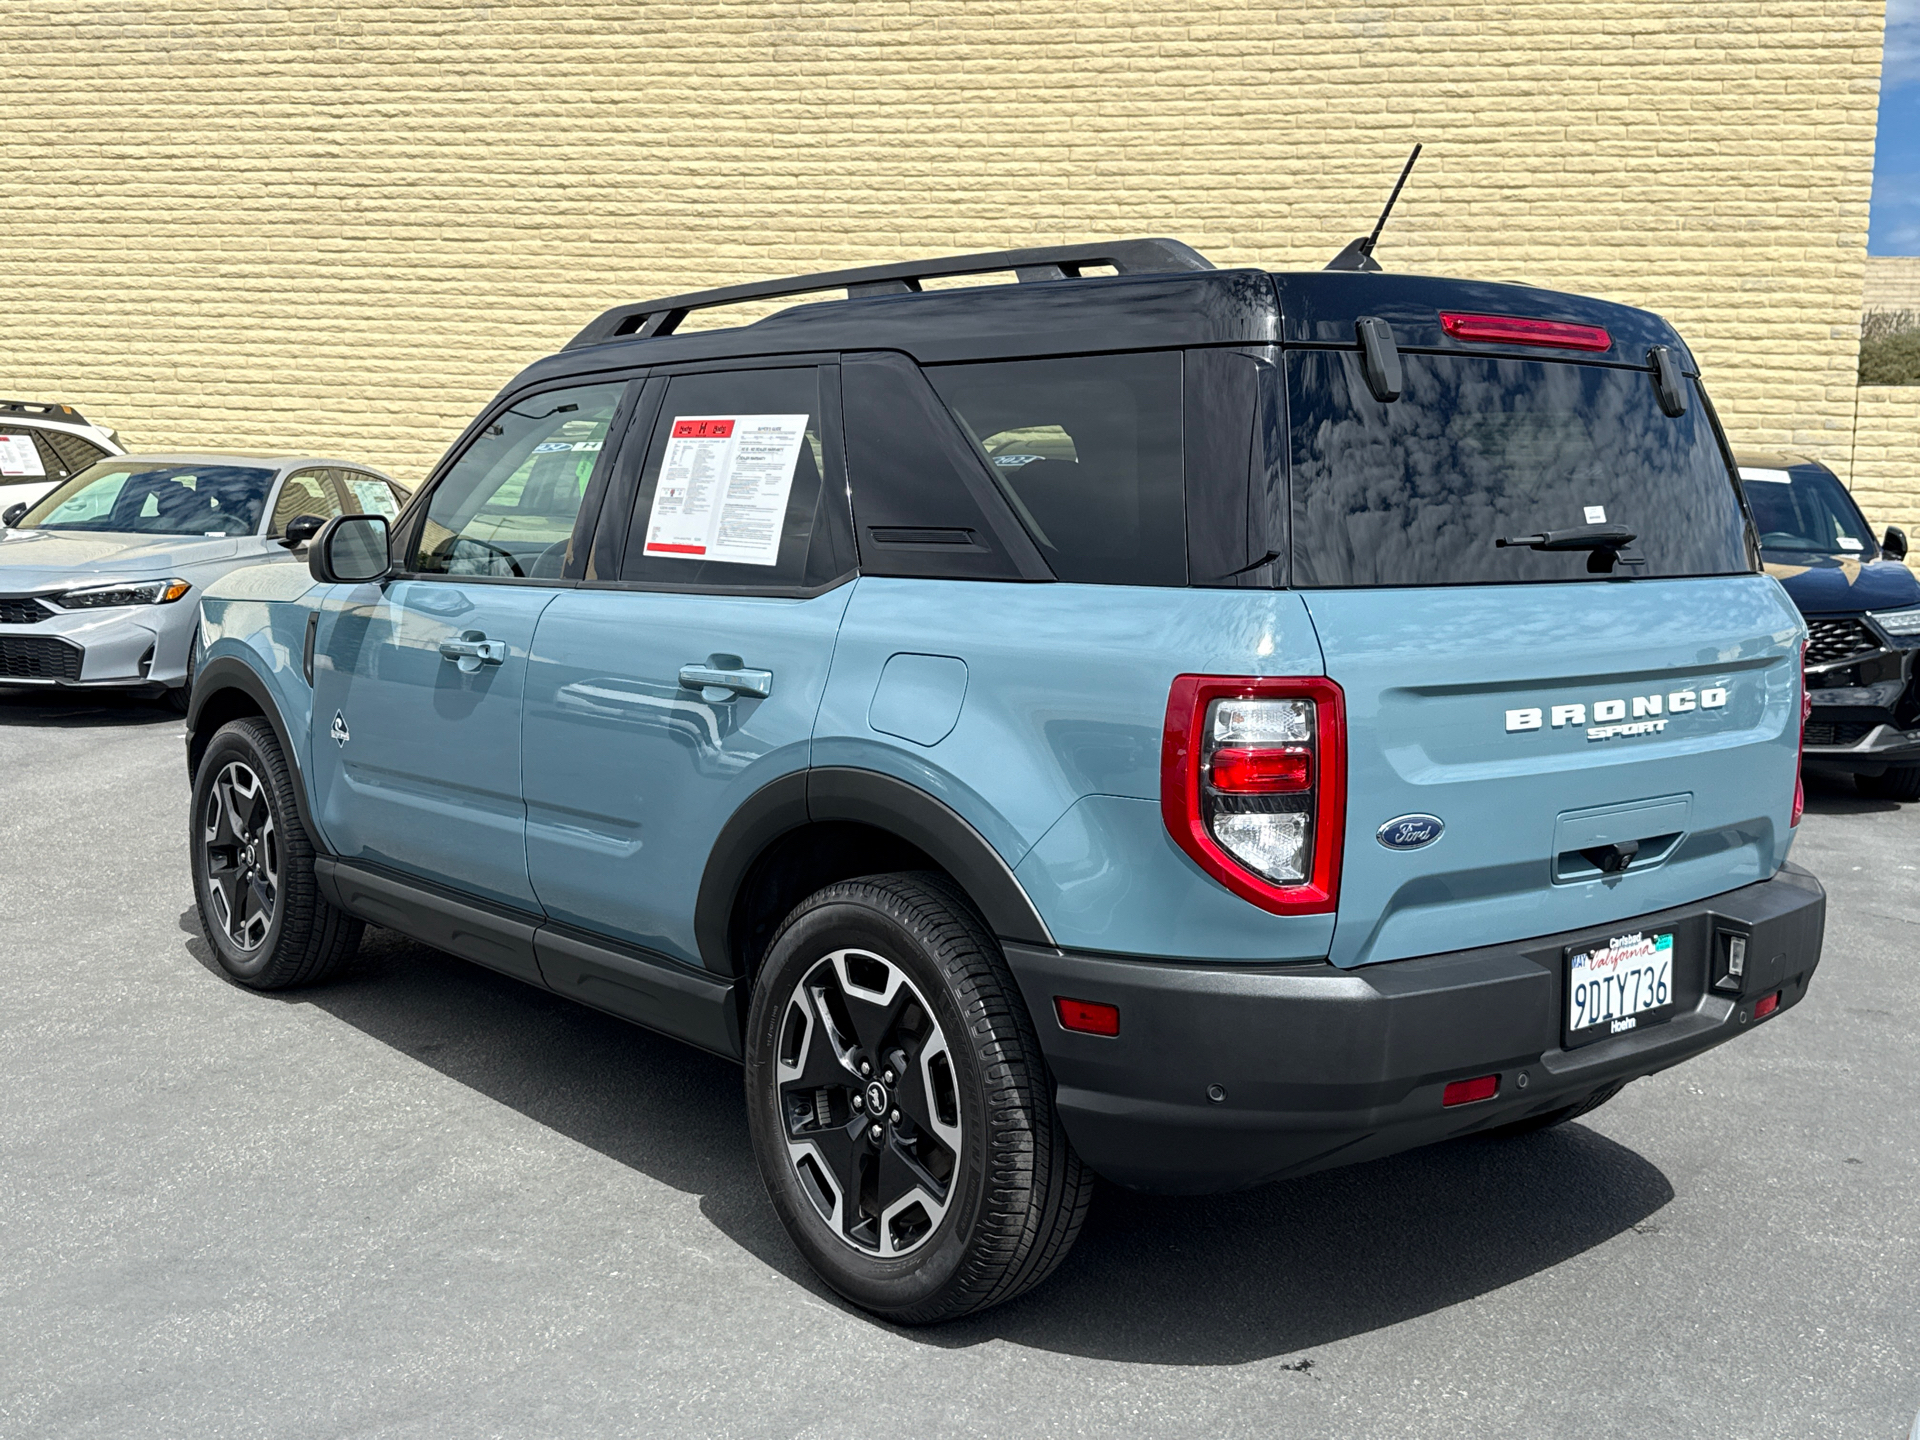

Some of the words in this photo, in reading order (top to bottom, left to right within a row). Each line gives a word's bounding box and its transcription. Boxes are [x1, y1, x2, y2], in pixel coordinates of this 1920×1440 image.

[1505, 688, 1727, 731] BRONCO
[1587, 719, 1669, 740] SPORT
[1395, 822, 1432, 843] Ford
[1609, 932, 1642, 949] Carlsbad
[1571, 954, 1587, 968] MAY
[1589, 944, 1656, 972] California
[1574, 961, 1668, 1028] 9DIY736
